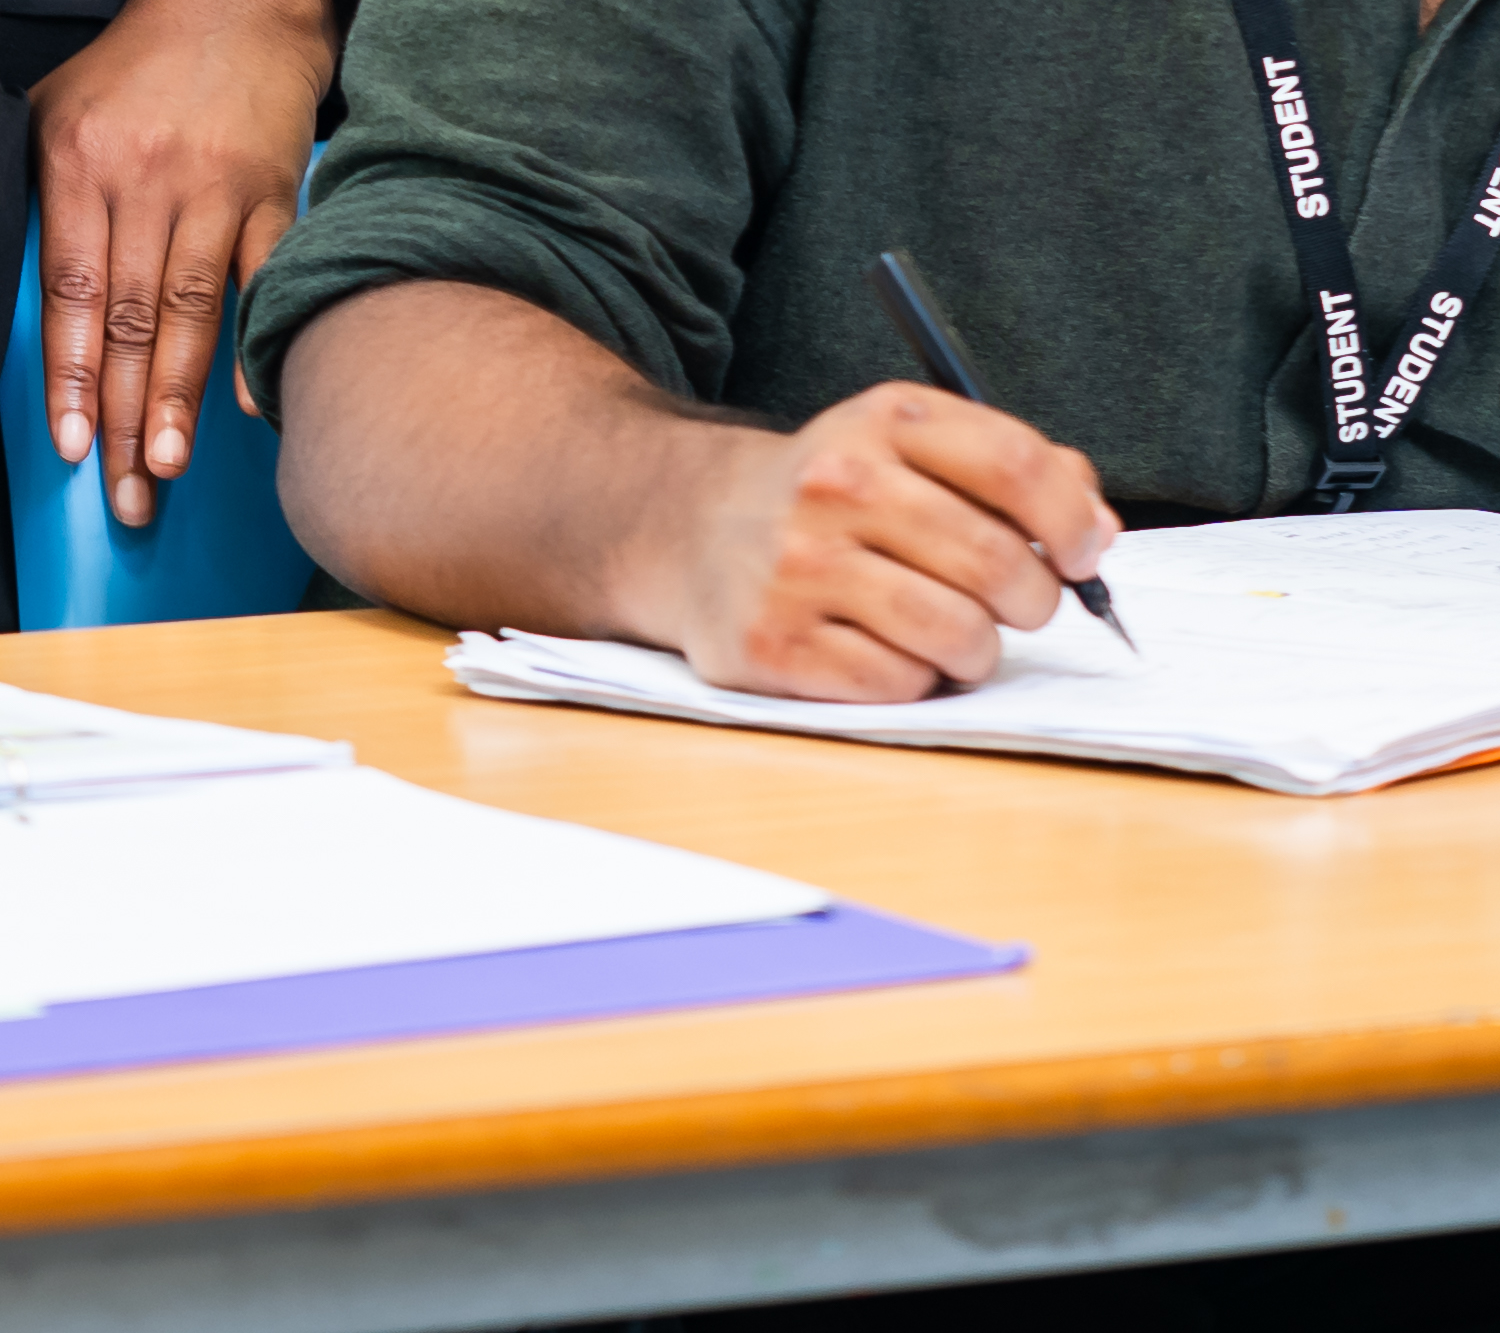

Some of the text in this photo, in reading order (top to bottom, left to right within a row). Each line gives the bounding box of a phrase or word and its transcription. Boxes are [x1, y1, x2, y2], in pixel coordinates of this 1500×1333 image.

[1263, 56, 1330, 219] STUDENT
[1320, 290, 1369, 443] STUDENT
[1373, 291, 1463, 439] STUDENT
